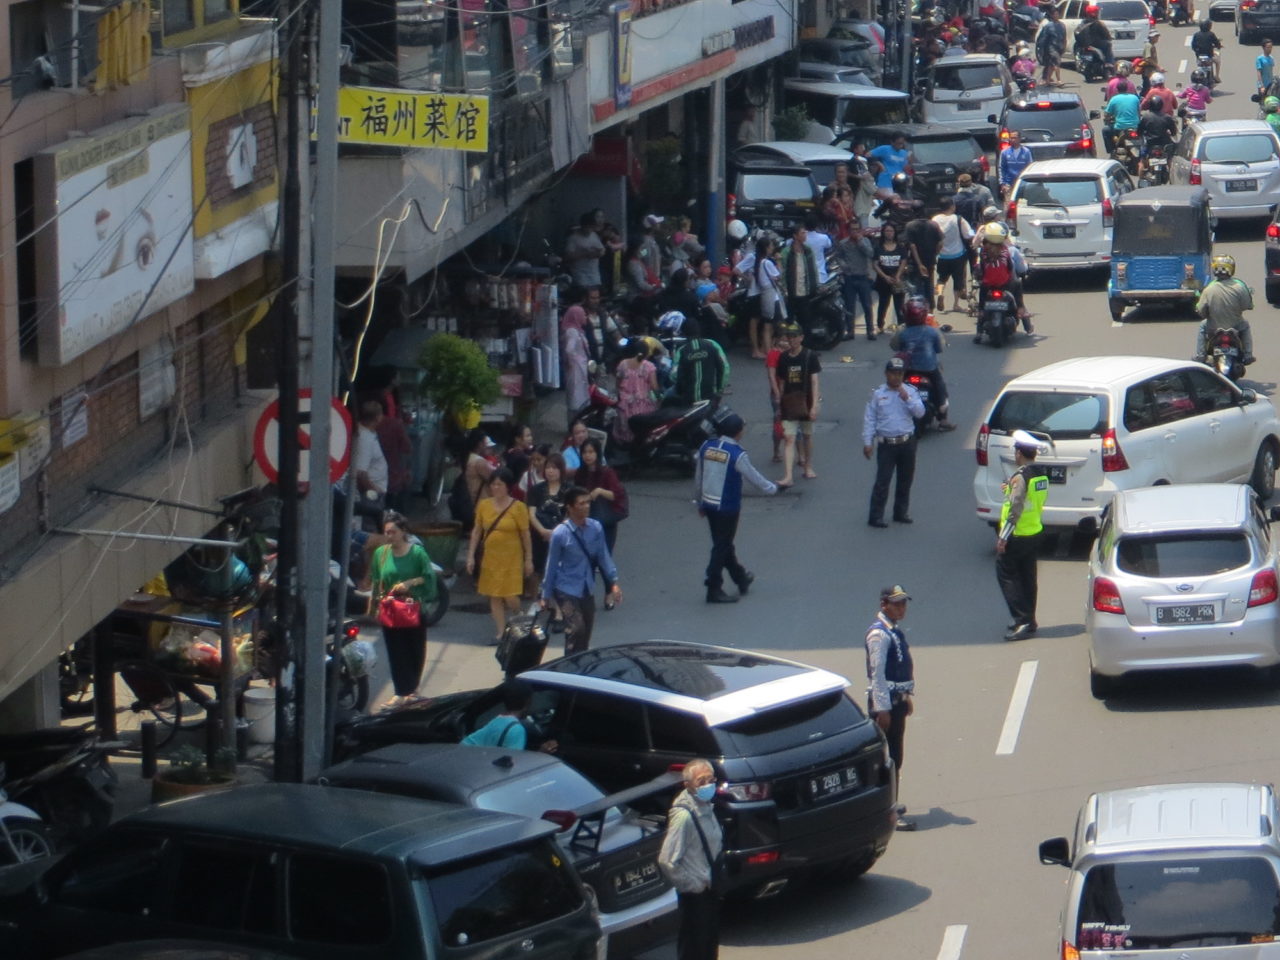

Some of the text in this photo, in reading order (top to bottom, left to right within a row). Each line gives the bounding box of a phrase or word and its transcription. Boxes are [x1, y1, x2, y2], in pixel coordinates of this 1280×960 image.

[360, 95, 480, 143] 福州菜馆
[1157, 605, 1213, 618] B 1982 PRK
